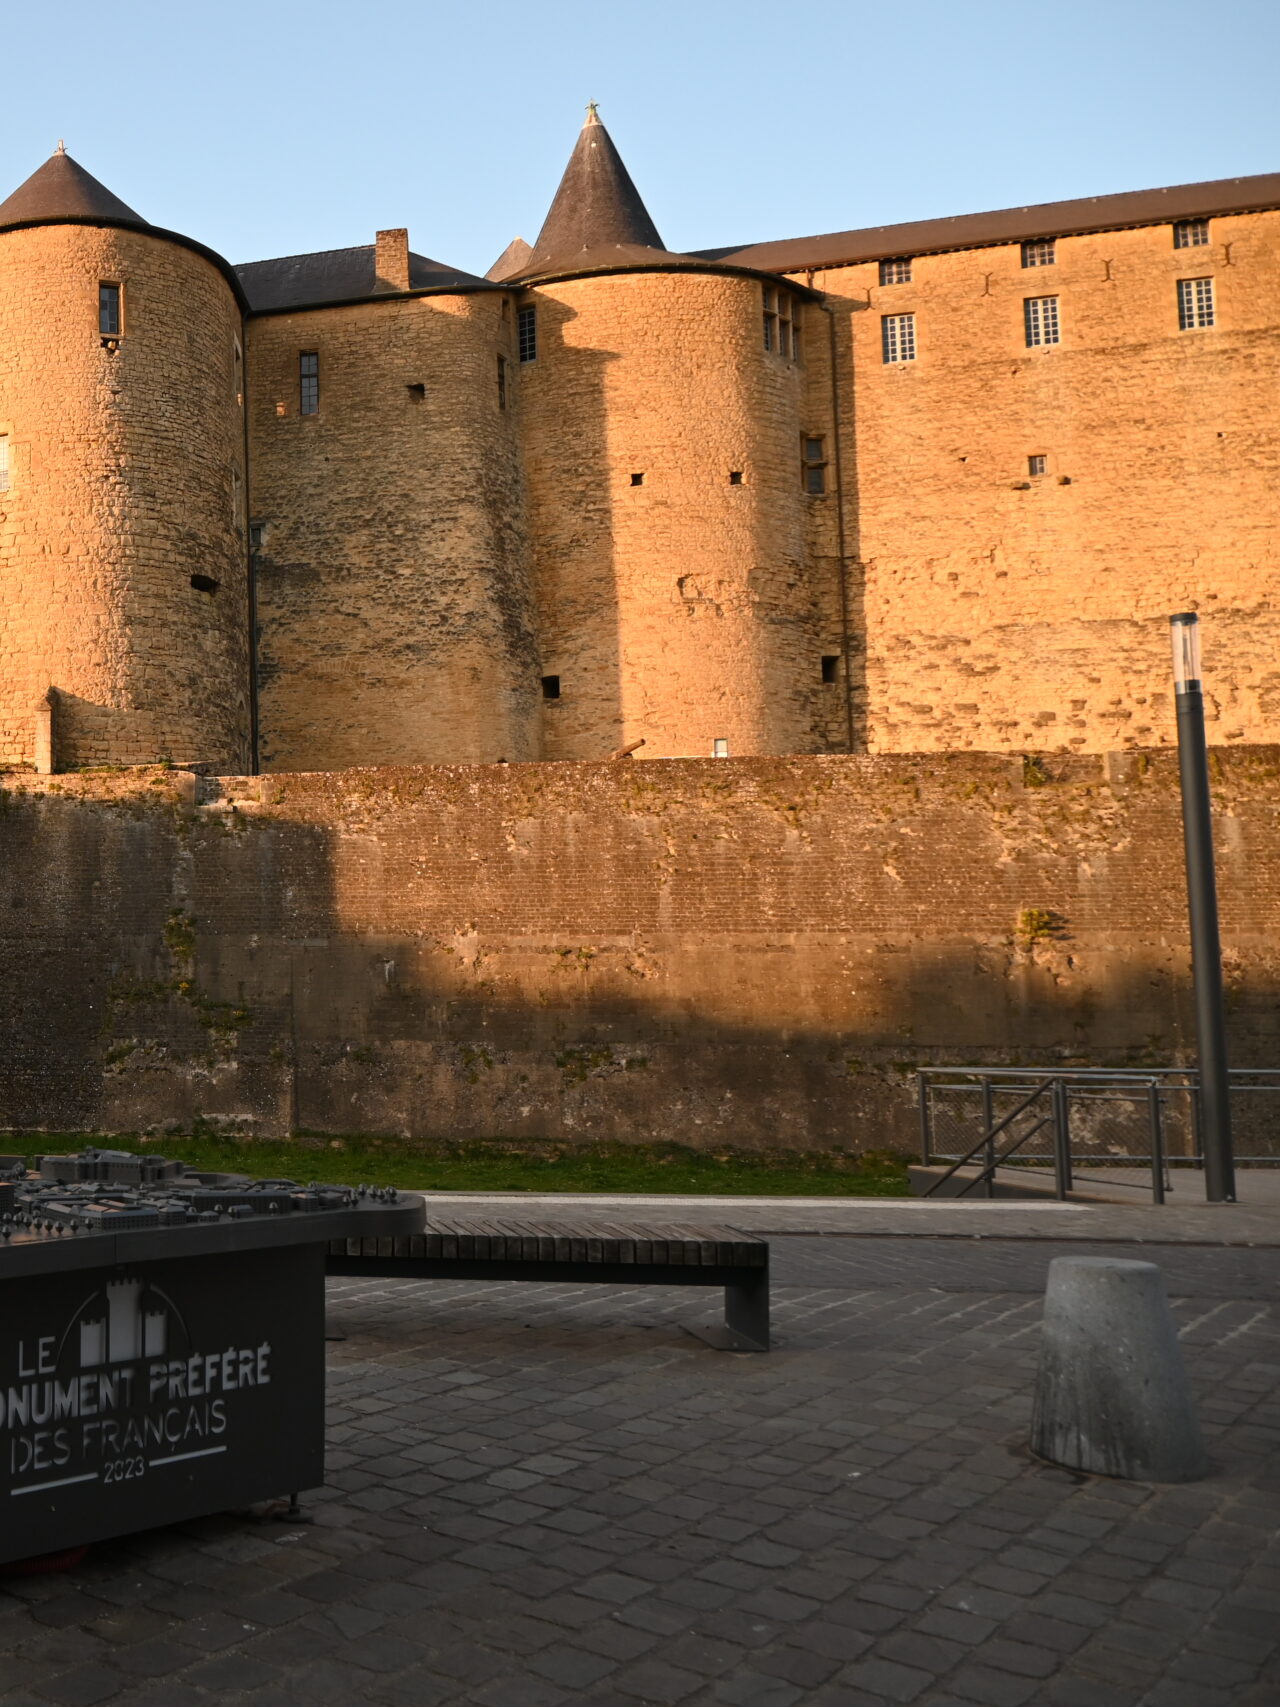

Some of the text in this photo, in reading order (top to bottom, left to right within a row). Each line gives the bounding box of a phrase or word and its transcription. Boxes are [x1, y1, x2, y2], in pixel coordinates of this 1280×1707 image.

[18, 1335, 57, 1378] LE
[149, 1341, 272, 1404] PRÉFÉRÉ
[10, 1398, 228, 1475] DES FRANÇAIS
[103, 1455, 145, 1484] 2023
